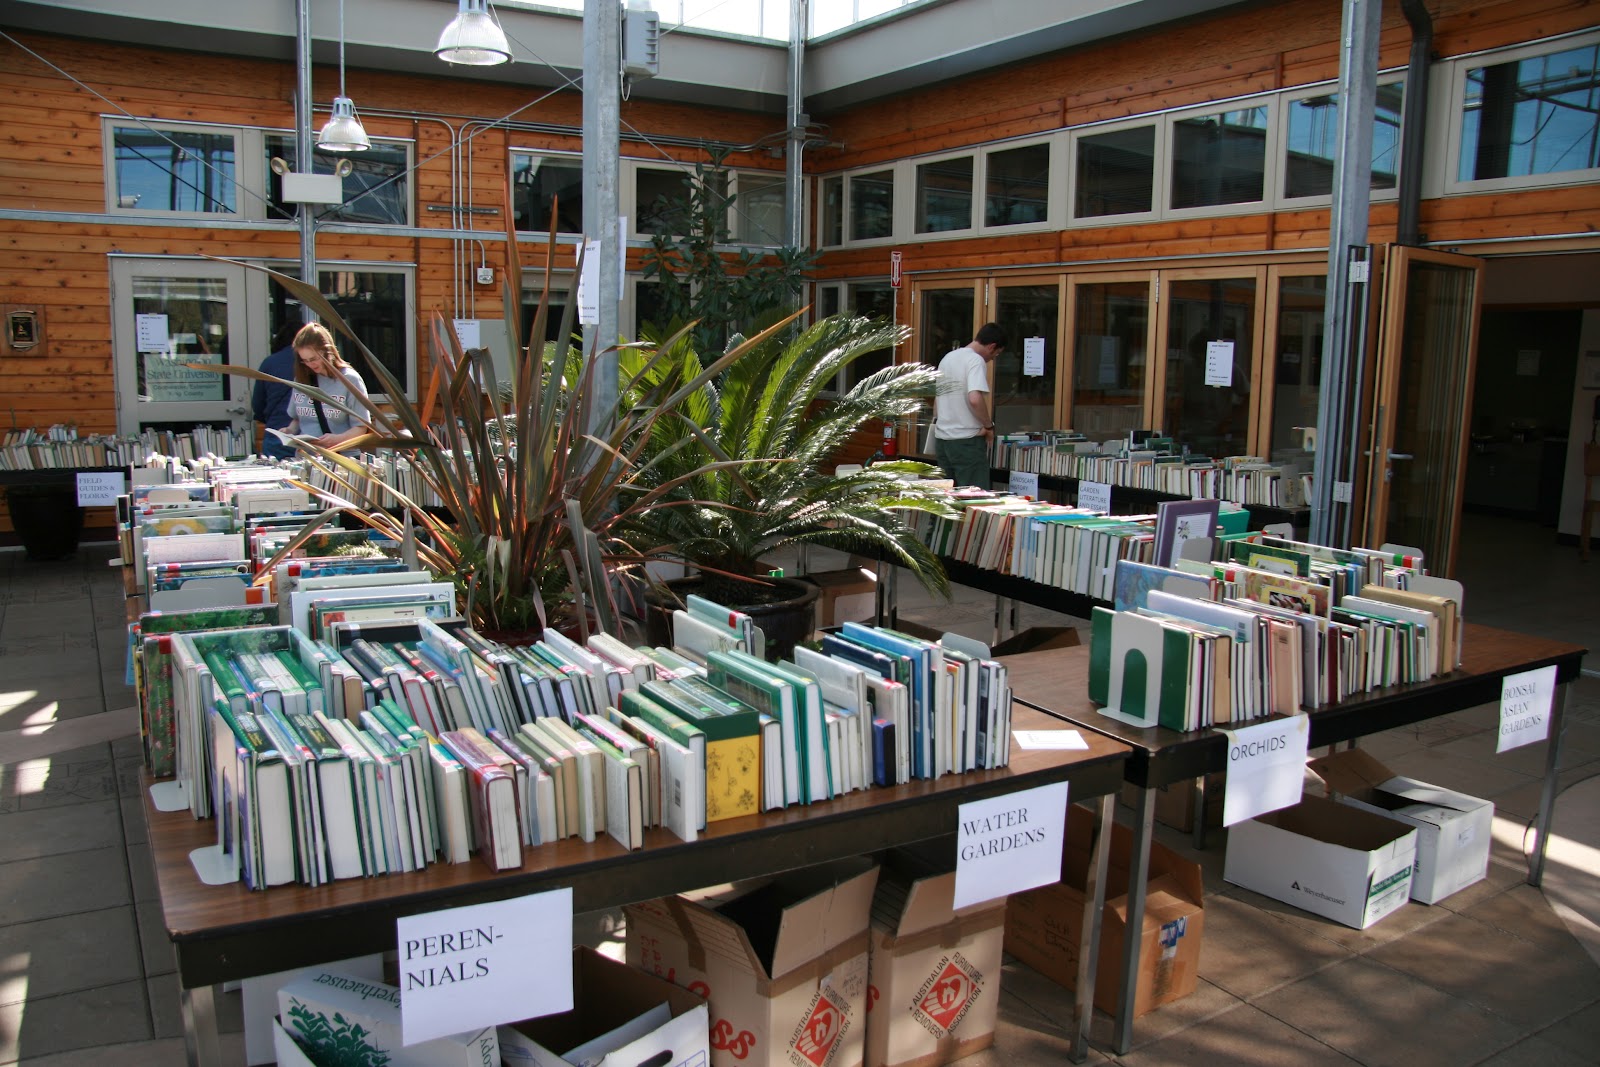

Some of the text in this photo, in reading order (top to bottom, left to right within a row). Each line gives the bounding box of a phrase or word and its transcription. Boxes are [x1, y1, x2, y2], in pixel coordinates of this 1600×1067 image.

[147, 370, 219, 381] State University
[1010, 476, 1035, 484] LANDSCAPE
[1010, 484, 1028, 492] HISTORY
[1079, 486, 1100, 494] GARDEN
[1079, 494, 1107, 504] LITERATURE
[1090, 503, 1108, 511] ESSAYS
[1503, 682, 1536, 701] BONSAI
[1502, 701, 1529, 718] ASIAN
[1501, 714, 1542, 736] GARDENS
[1230, 734, 1286, 761] ORCHIDS
[963, 807, 1028, 836] WATER
[961, 827, 1045, 861] GARDENS
[1303, 886, 1346, 906] Weyerhaeuser
[405, 925, 504, 960] PEREN-
[406, 957, 489, 990] NIALS
[912, 955, 949, 1006] AUSTRALIAN
[952, 951, 983, 984] FURNITURE
[312, 972, 402, 1010] eyerhaeuser
[823, 984, 852, 1016] FURNITURE
[789, 991, 821, 1048] AUSTRALIAN
[911, 1008, 944, 1040] REMOVERS
[947, 987, 982, 1035] ASSOCIATION
[480, 1037, 495, 1067] opy
[823, 1019, 851, 1067] SSOCIATION
